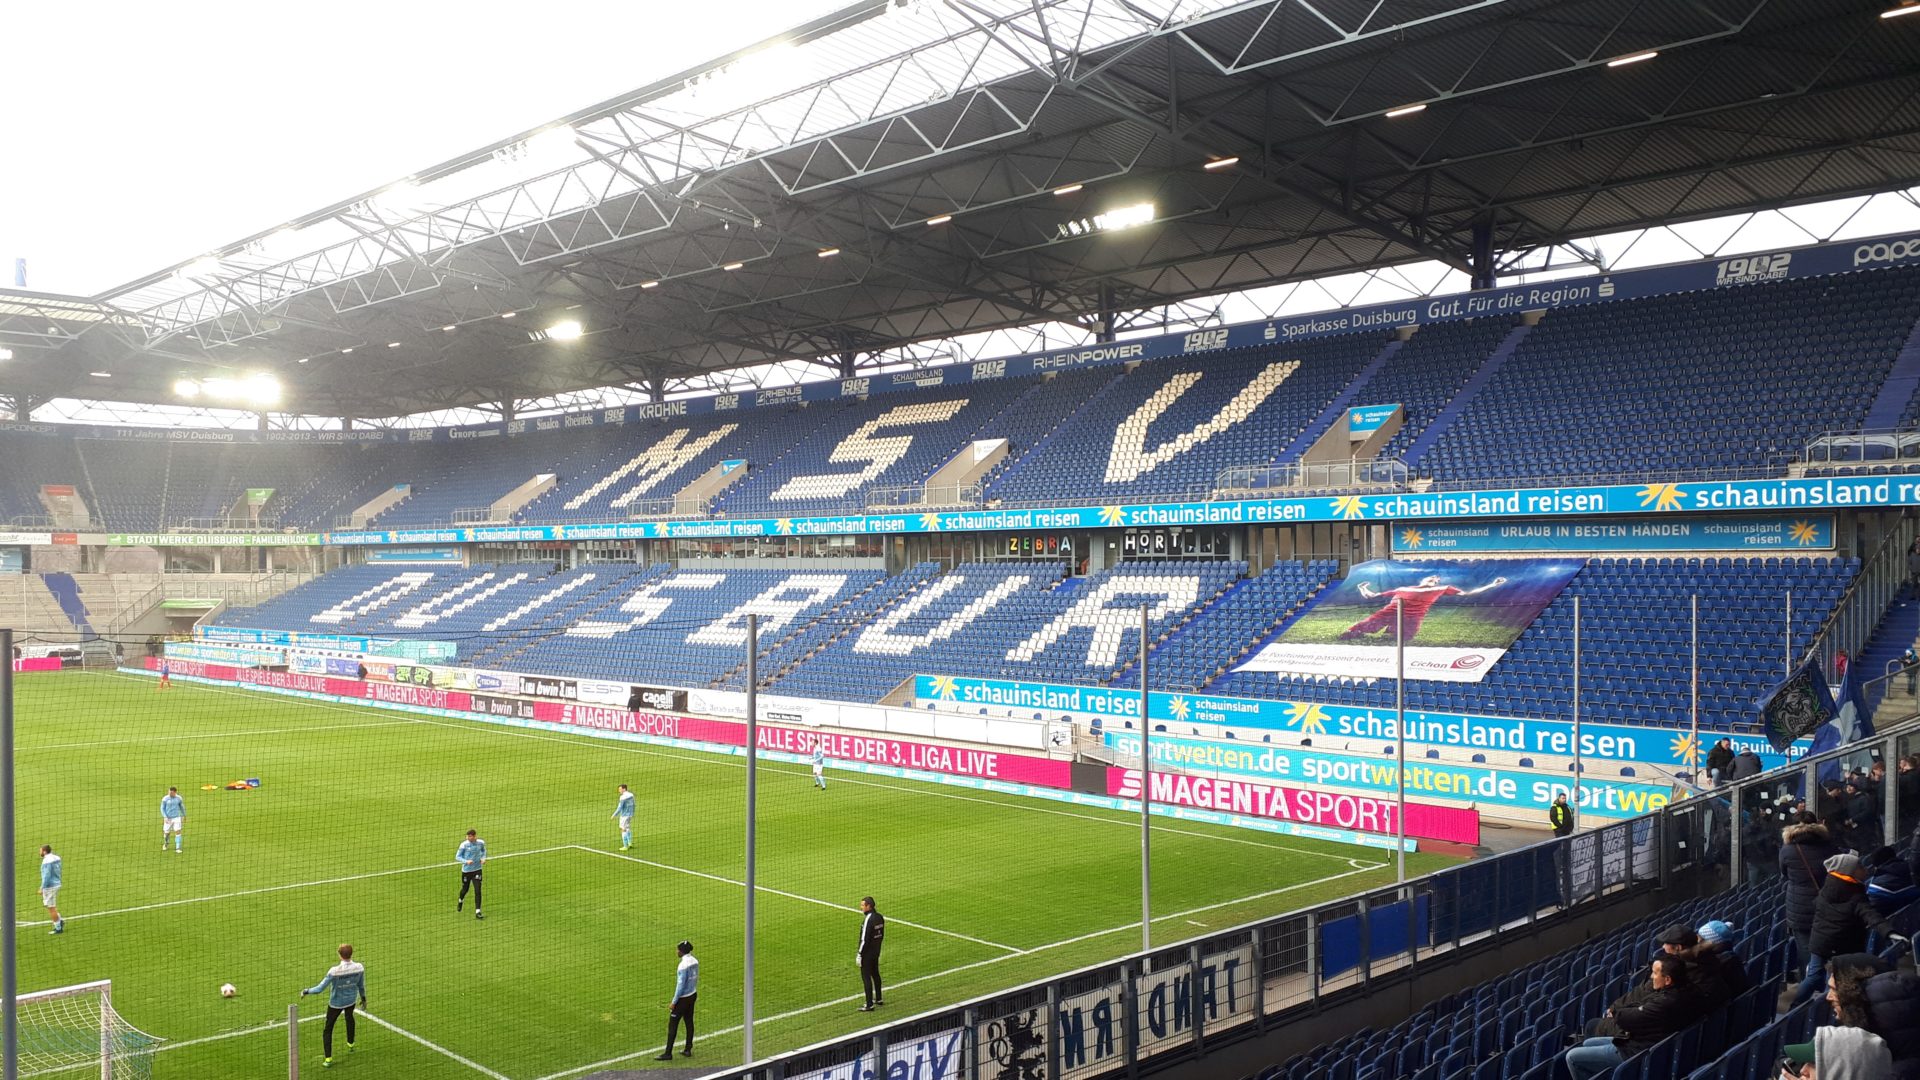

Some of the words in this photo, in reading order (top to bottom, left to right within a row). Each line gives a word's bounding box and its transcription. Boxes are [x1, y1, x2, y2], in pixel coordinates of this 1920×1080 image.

[1716, 252, 1793, 280] 1902
[1716, 277, 1733, 286] WIR
[1734, 274, 1757, 284] SIND
[1759, 270, 1788, 281] DABEI
[1427, 300, 1464, 320] Gut.
[1467, 297, 1494, 313] Für
[1498, 292, 1525, 308] die
[1529, 286, 1591, 309] Region
[1282, 319, 1348, 338] Sparkasse
[1352, 307, 1417, 328] Duisburg
[1184, 329, 1229, 348] 1902
[1033, 344, 1144, 370] RHEINPOWER
[892, 368, 943, 384] SCHAUINSLAND
[972, 360, 1006, 377] 1902
[765, 386, 802, 398] RHENUS
[841, 377, 870, 392] 1902
[715, 394, 739, 407] 1902
[765, 396, 802, 406] LOGISTICS
[604, 408, 625, 420] 1902
[639, 400, 687, 420] KROHNE
[565, 414, 593, 428] Rheinfels
[166, 431, 190, 440] MSV
[190, 431, 234, 442] Duisburg
[318, 432, 336, 440] WIR
[337, 432, 358, 440] SIND
[359, 431, 384, 440] DABEI
[1695, 478, 1889, 508] schauinsland
[1373, 490, 1520, 517] schauinsland
[1528, 489, 1604, 513] reisen
[945, 509, 1031, 530] schauinsland
[1035, 511, 1080, 527] reisen
[1131, 502, 1242, 526] schauinsland
[1247, 500, 1306, 522] reisen
[566, 525, 617, 540] schauinsland
[618, 524, 645, 538] reisen
[672, 522, 730, 537] schauinsland
[731, 521, 764, 535] reisen
[796, 516, 866, 534] schauinsland
[869, 516, 906, 532] reisen
[1427, 526, 1489, 538] schauinsland
[1500, 525, 1551, 538] URLAUB
[1555, 525, 1570, 538] IN
[1575, 525, 1627, 538] BESTEN
[1632, 522, 1690, 537] HÄNDEN
[1703, 521, 1782, 535] schauinsland
[126, 535, 194, 545] STADTWERKE
[195, 535, 245, 545] DUISBURG
[332, 532, 364, 545] schauinsland
[365, 533, 382, 544] reisen
[399, 531, 437, 543] schauinsland
[437, 531, 457, 542] reisen
[477, 528, 520, 541] schauinsland
[521, 528, 544, 541] reisen
[1125, 532, 1179, 551] HORT
[1427, 537, 1457, 548] reisen
[1743, 533, 1782, 545] reisen
[1009, 536, 1071, 551] ZEBRA
[1409, 659, 1449, 670] Cichon
[236, 668, 250, 683] ALLE
[250, 670, 271, 686] SPIELE
[271, 673, 286, 688] DER
[294, 676, 310, 690] LIGA
[311, 678, 326, 693] LIVE
[582, 683, 624, 694] ESP
[376, 685, 419, 705] MAGENTA
[419, 687, 449, 709] SPORT
[536, 681, 559, 697] bwin
[964, 681, 1081, 711] schauinsland
[642, 690, 674, 708] capelli
[1195, 699, 1260, 714] schauinsland
[490, 701, 513, 716] bwin
[575, 706, 637, 733] MAGENTA
[638, 712, 681, 737] SPORT
[1195, 711, 1226, 723] reisen
[1338, 711, 1525, 749] schauinsland
[1536, 720, 1636, 759] reisen
[757, 728, 793, 750] ALLE
[797, 731, 851, 758] SPIELE
[854, 737, 887, 763] DER
[891, 741, 908, 766] 3.
[911, 745, 951, 771] LIGA
[956, 750, 998, 777] LIVE
[1118, 736, 1291, 775] sportwetten.de
[1302, 756, 1517, 800] sportwetten.de
[1150, 771, 1291, 819] MAGENTA
[1296, 789, 1399, 833] SPORT
